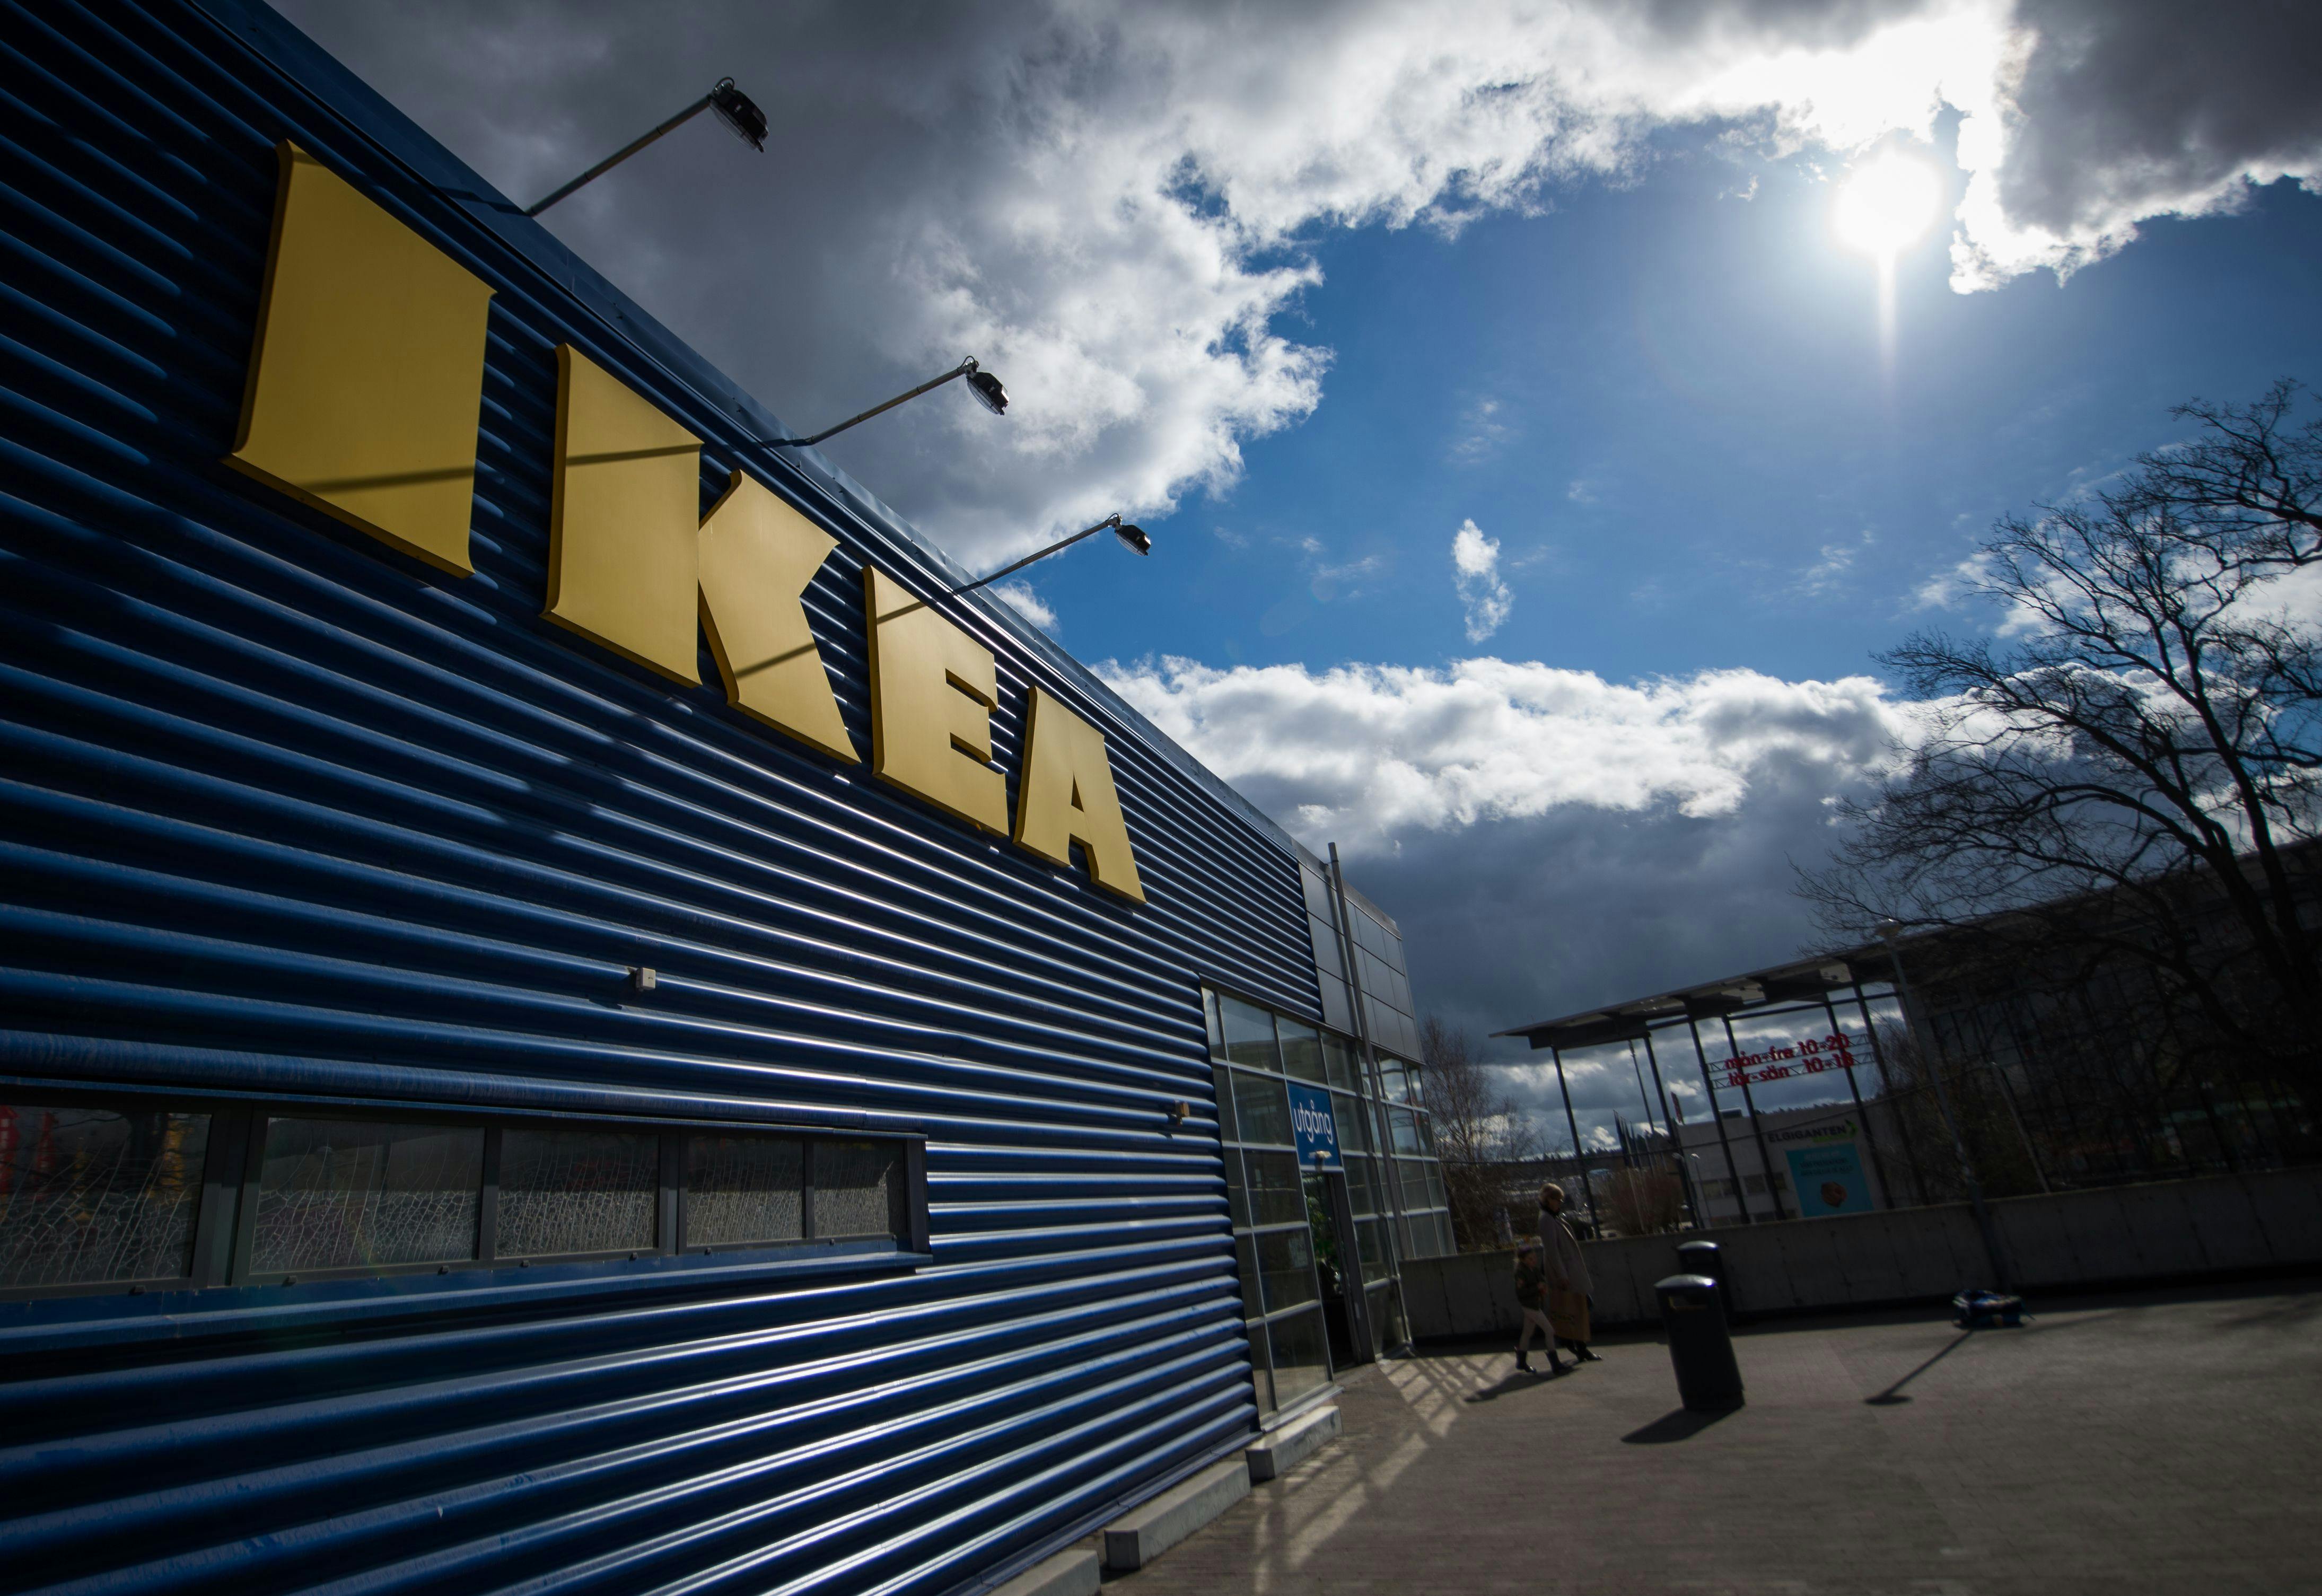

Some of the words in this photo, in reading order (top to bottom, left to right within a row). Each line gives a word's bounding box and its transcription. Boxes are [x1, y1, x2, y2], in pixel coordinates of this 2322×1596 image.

[223, 140, 1146, 905] IKEA
[1797, 1032, 1850, 1056] 10-20
[1294, 1099, 1333, 1145] utgång
[1767, 1125, 1846, 1143] ELGIGANTEN
